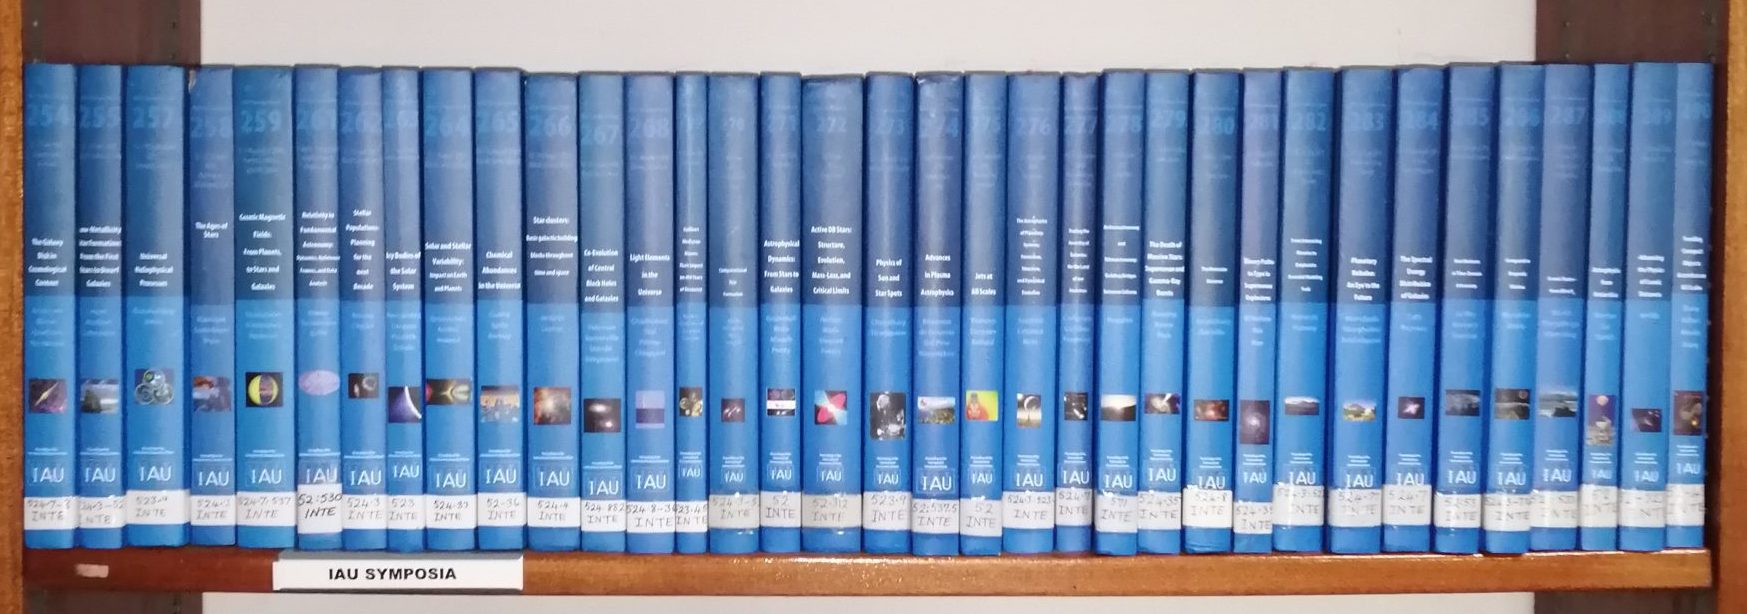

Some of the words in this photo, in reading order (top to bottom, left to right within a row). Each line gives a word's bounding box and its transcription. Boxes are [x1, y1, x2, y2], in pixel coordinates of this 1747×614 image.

[241, 110, 281, 133] 259
[582, 125, 619, 145] 267
[764, 240, 800, 248] Astrophysical
[486, 251, 513, 259] Chemical
[630, 254, 644, 262] Light
[594, 264, 614, 272] Central
[888, 290, 902, 298] Spots
[33, 467, 64, 483] IAU
[85, 467, 115, 483] IAU
[140, 466, 172, 482] IAU
[306, 467, 337, 483] IAU
[393, 465, 420, 478] IAU
[682, 467, 701, 478] IAU
[770, 469, 792, 481] IAU
[1148, 468, 1176, 482] IAU
[1543, 468, 1572, 482] IAU
[1592, 469, 1612, 480] IAU
[1676, 463, 1699, 475] IAU
[199, 471, 230, 486] IAU
[251, 469, 282, 484] IAU
[350, 470, 381, 486] IAU
[435, 473, 467, 488] IAU
[486, 469, 517, 484] IAU
[539, 471, 570, 487] IAU
[637, 474, 666, 490] IAU
[725, 472, 744, 483] IAU
[821, 470, 842, 482] IAU
[878, 472, 899, 484] IAU
[972, 472, 993, 484] IAU
[1015, 473, 1043, 487] IAU
[1063, 470, 1090, 484] IAU
[1105, 474, 1133, 488] IAU
[1198, 475, 1226, 489] IAU
[1243, 472, 1267, 484] IAU
[1288, 471, 1316, 485] IAU
[1346, 474, 1374, 488] IAU
[1396, 472, 1425, 485] IAU
[1448, 470, 1477, 484] IAU
[1498, 472, 1526, 485] IAU
[1634, 470, 1659, 482] IAU
[589, 480, 619, 495] IAU
[922, 475, 952, 491] IAU
[305, 507, 336, 518] INTE
[488, 510, 516, 520] INTE
[539, 511, 566, 521] INTE
[765, 507, 795, 519] INTE
[872, 510, 904, 523] INTE
[1014, 507, 1047, 520] INTE
[1058, 506, 1089, 516] INTE
[1101, 509, 1132, 522] INTE
[1140, 510, 1178, 519] INTE
[635, 517, 673, 528] INTE
[918, 516, 950, 527] INTE
[966, 516, 996, 528] INTE
[329, 568, 358, 579] IAU
[366, 568, 456, 579] SYMPOSIA
